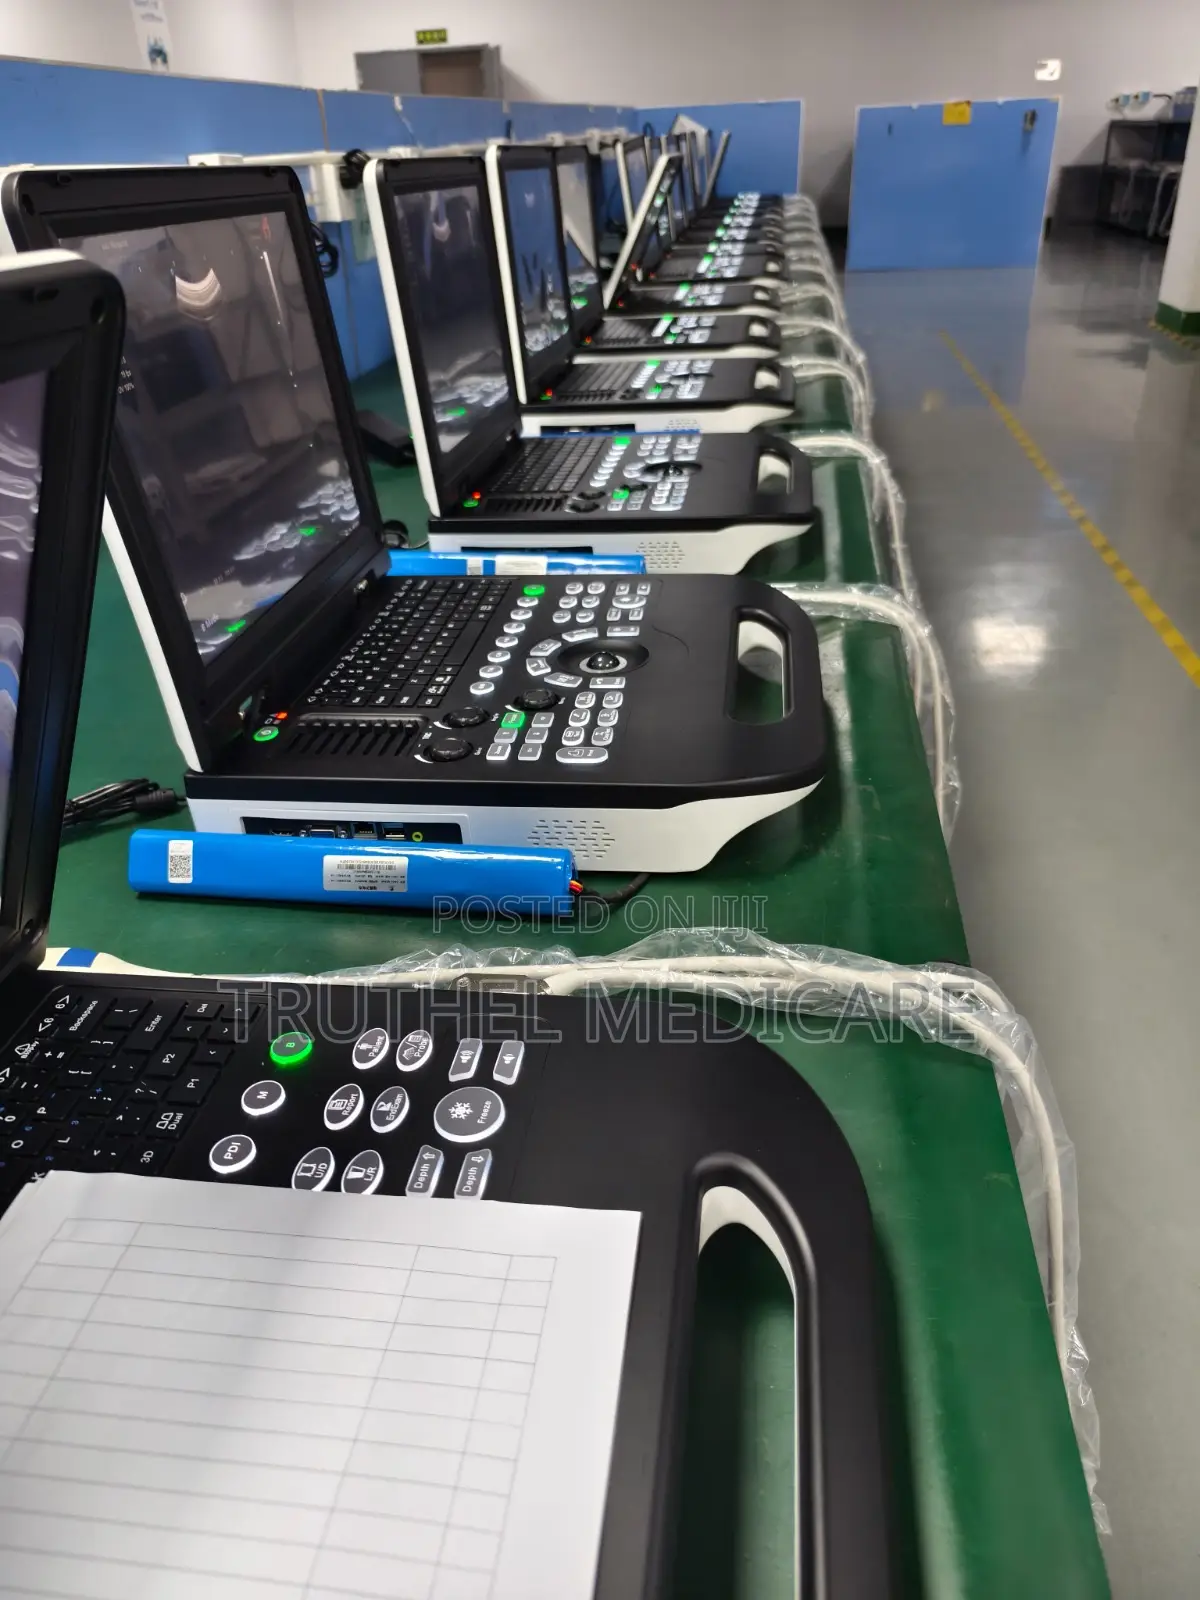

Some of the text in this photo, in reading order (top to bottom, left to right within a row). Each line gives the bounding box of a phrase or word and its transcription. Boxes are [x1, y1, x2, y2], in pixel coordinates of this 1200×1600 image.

[69, 1000, 98, 1031] Backspace
[145, 1014, 162, 1032] Enter
[368, 1035, 386, 1058] Patient
[413, 1037, 429, 1058] Probe
[162, 1053, 176, 1064] P2
[186, 1078, 200, 1089] P1
[256, 1090, 269, 1099] M
[36, 1106, 47, 1115] P
[342, 1093, 358, 1116] Report
[477, 1100, 493, 1124] Freeze
[167, 1112, 184, 1130] Dual
[140, 1150, 154, 1163] 3D
[223, 1141, 241, 1160] PDI
[314, 1162, 328, 1179] U/D
[363, 1166, 377, 1182] L/R
[413, 1162, 431, 1189] Depth
[462, 1166, 478, 1193] Depth
